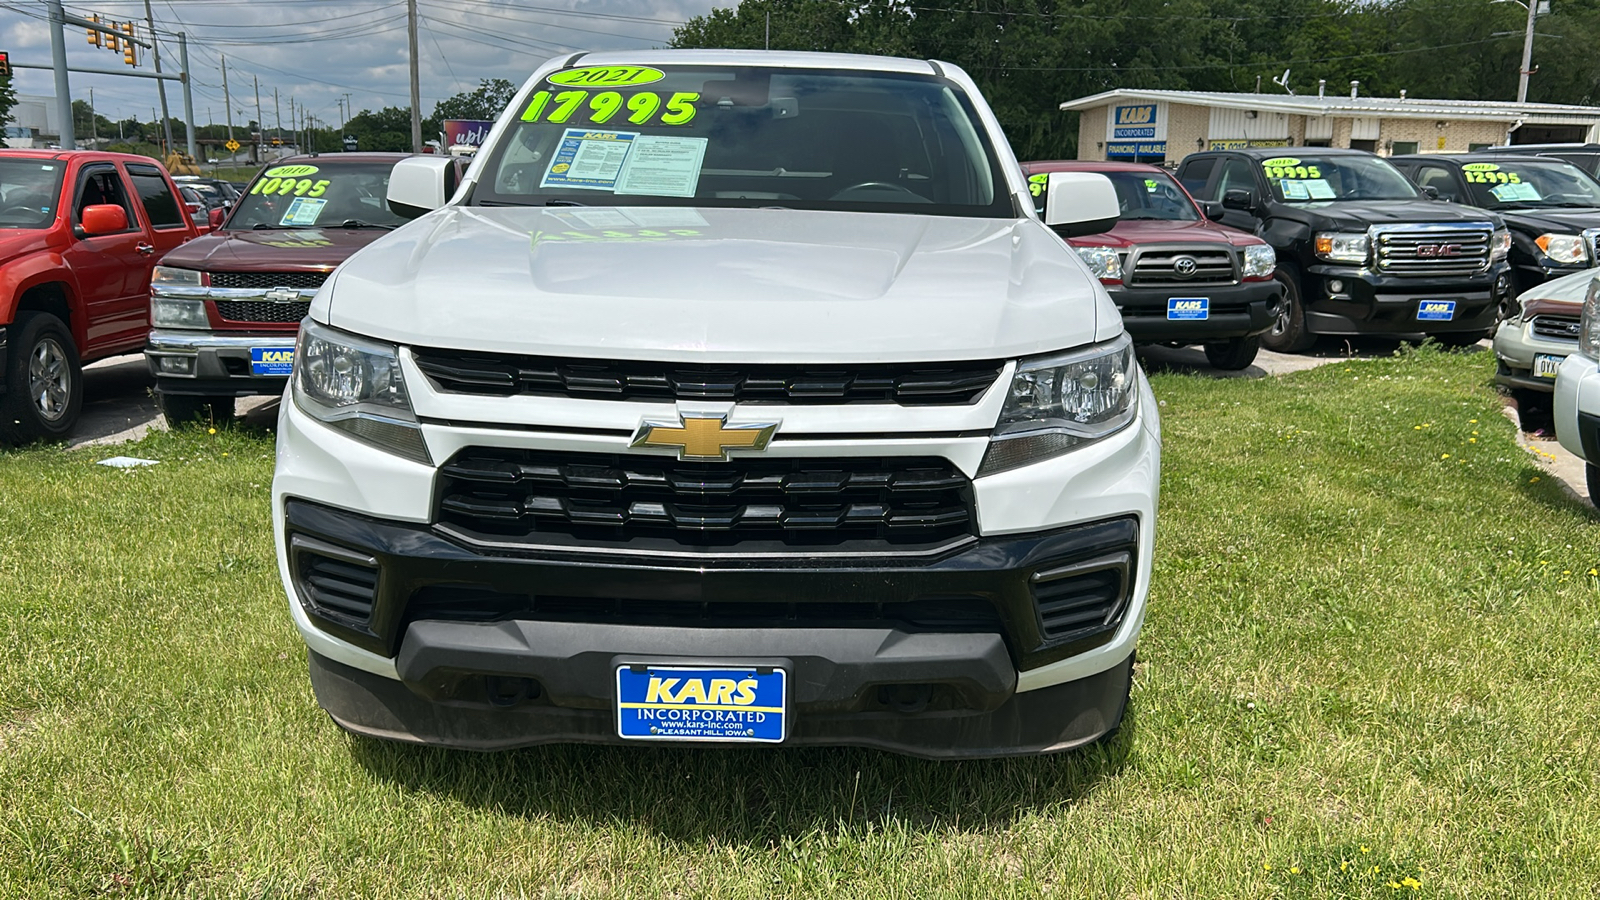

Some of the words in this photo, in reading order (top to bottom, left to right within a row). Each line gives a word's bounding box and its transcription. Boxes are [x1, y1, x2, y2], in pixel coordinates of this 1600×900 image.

[565, 69, 646, 83] 2021
[520, 91, 700, 125] 17995
[1119, 107, 1152, 124] KARS
[1115, 129, 1154, 137] INCORPORATED
[1108, 145, 1135, 153] FINANCING
[1139, 145, 1166, 153] AVAILABLE
[273, 166, 310, 175] 2010
[1264, 166, 1321, 179] 19995
[1464, 171, 1521, 184] 12995
[250, 178, 330, 197] 10995
[1417, 244, 1462, 257] GMC
[1175, 301, 1202, 309] KARS
[1425, 304, 1449, 312] KARS
[645, 677, 758, 705] KARS
[637, 708, 766, 723] INCORPORATED
[657, 728, 702, 736] PLEASANT
